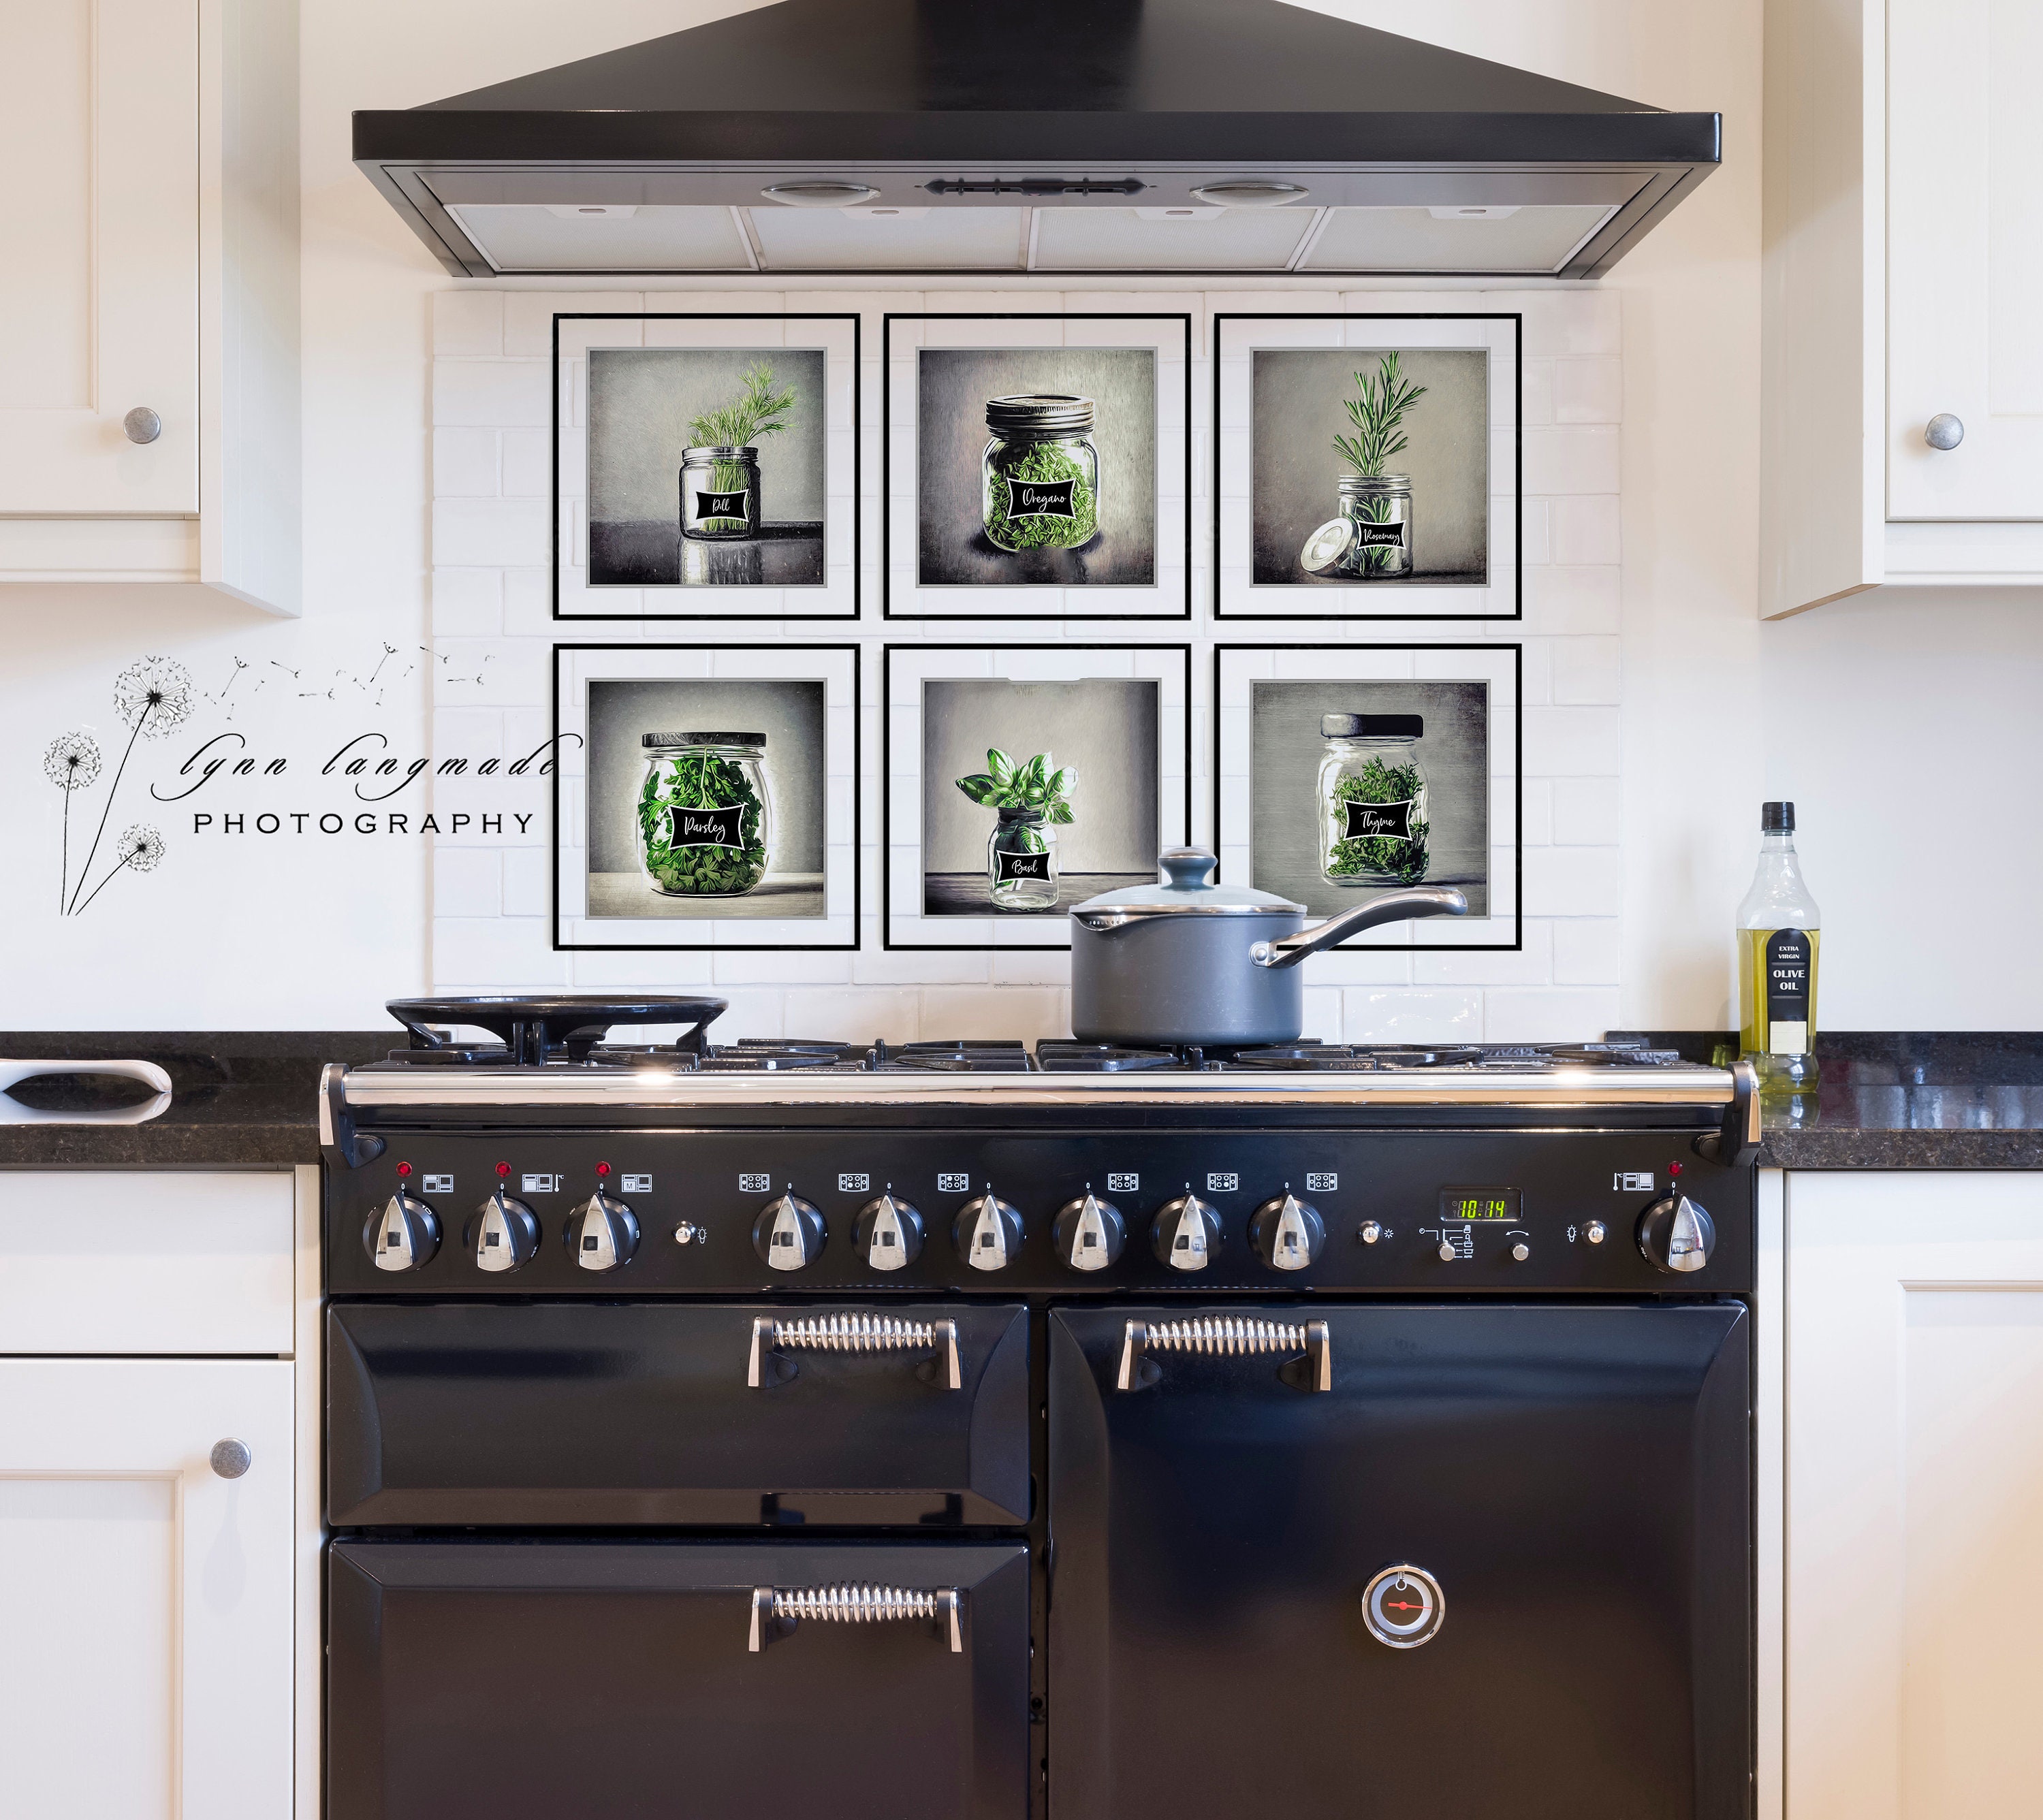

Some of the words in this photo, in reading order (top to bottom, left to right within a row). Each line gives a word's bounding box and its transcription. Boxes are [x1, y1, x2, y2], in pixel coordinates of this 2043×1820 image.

[712, 498, 731, 513] Dill
[1022, 488, 1067, 513] Oregano
[1363, 528, 1400, 547] Rosemary
[684, 815, 726, 843] Parsley
[1360, 810, 1396, 835] Thyme
[1011, 859, 1038, 875] Basil
[1773, 970, 1805, 978] OLIVE
[1779, 982, 1799, 991] OIL
